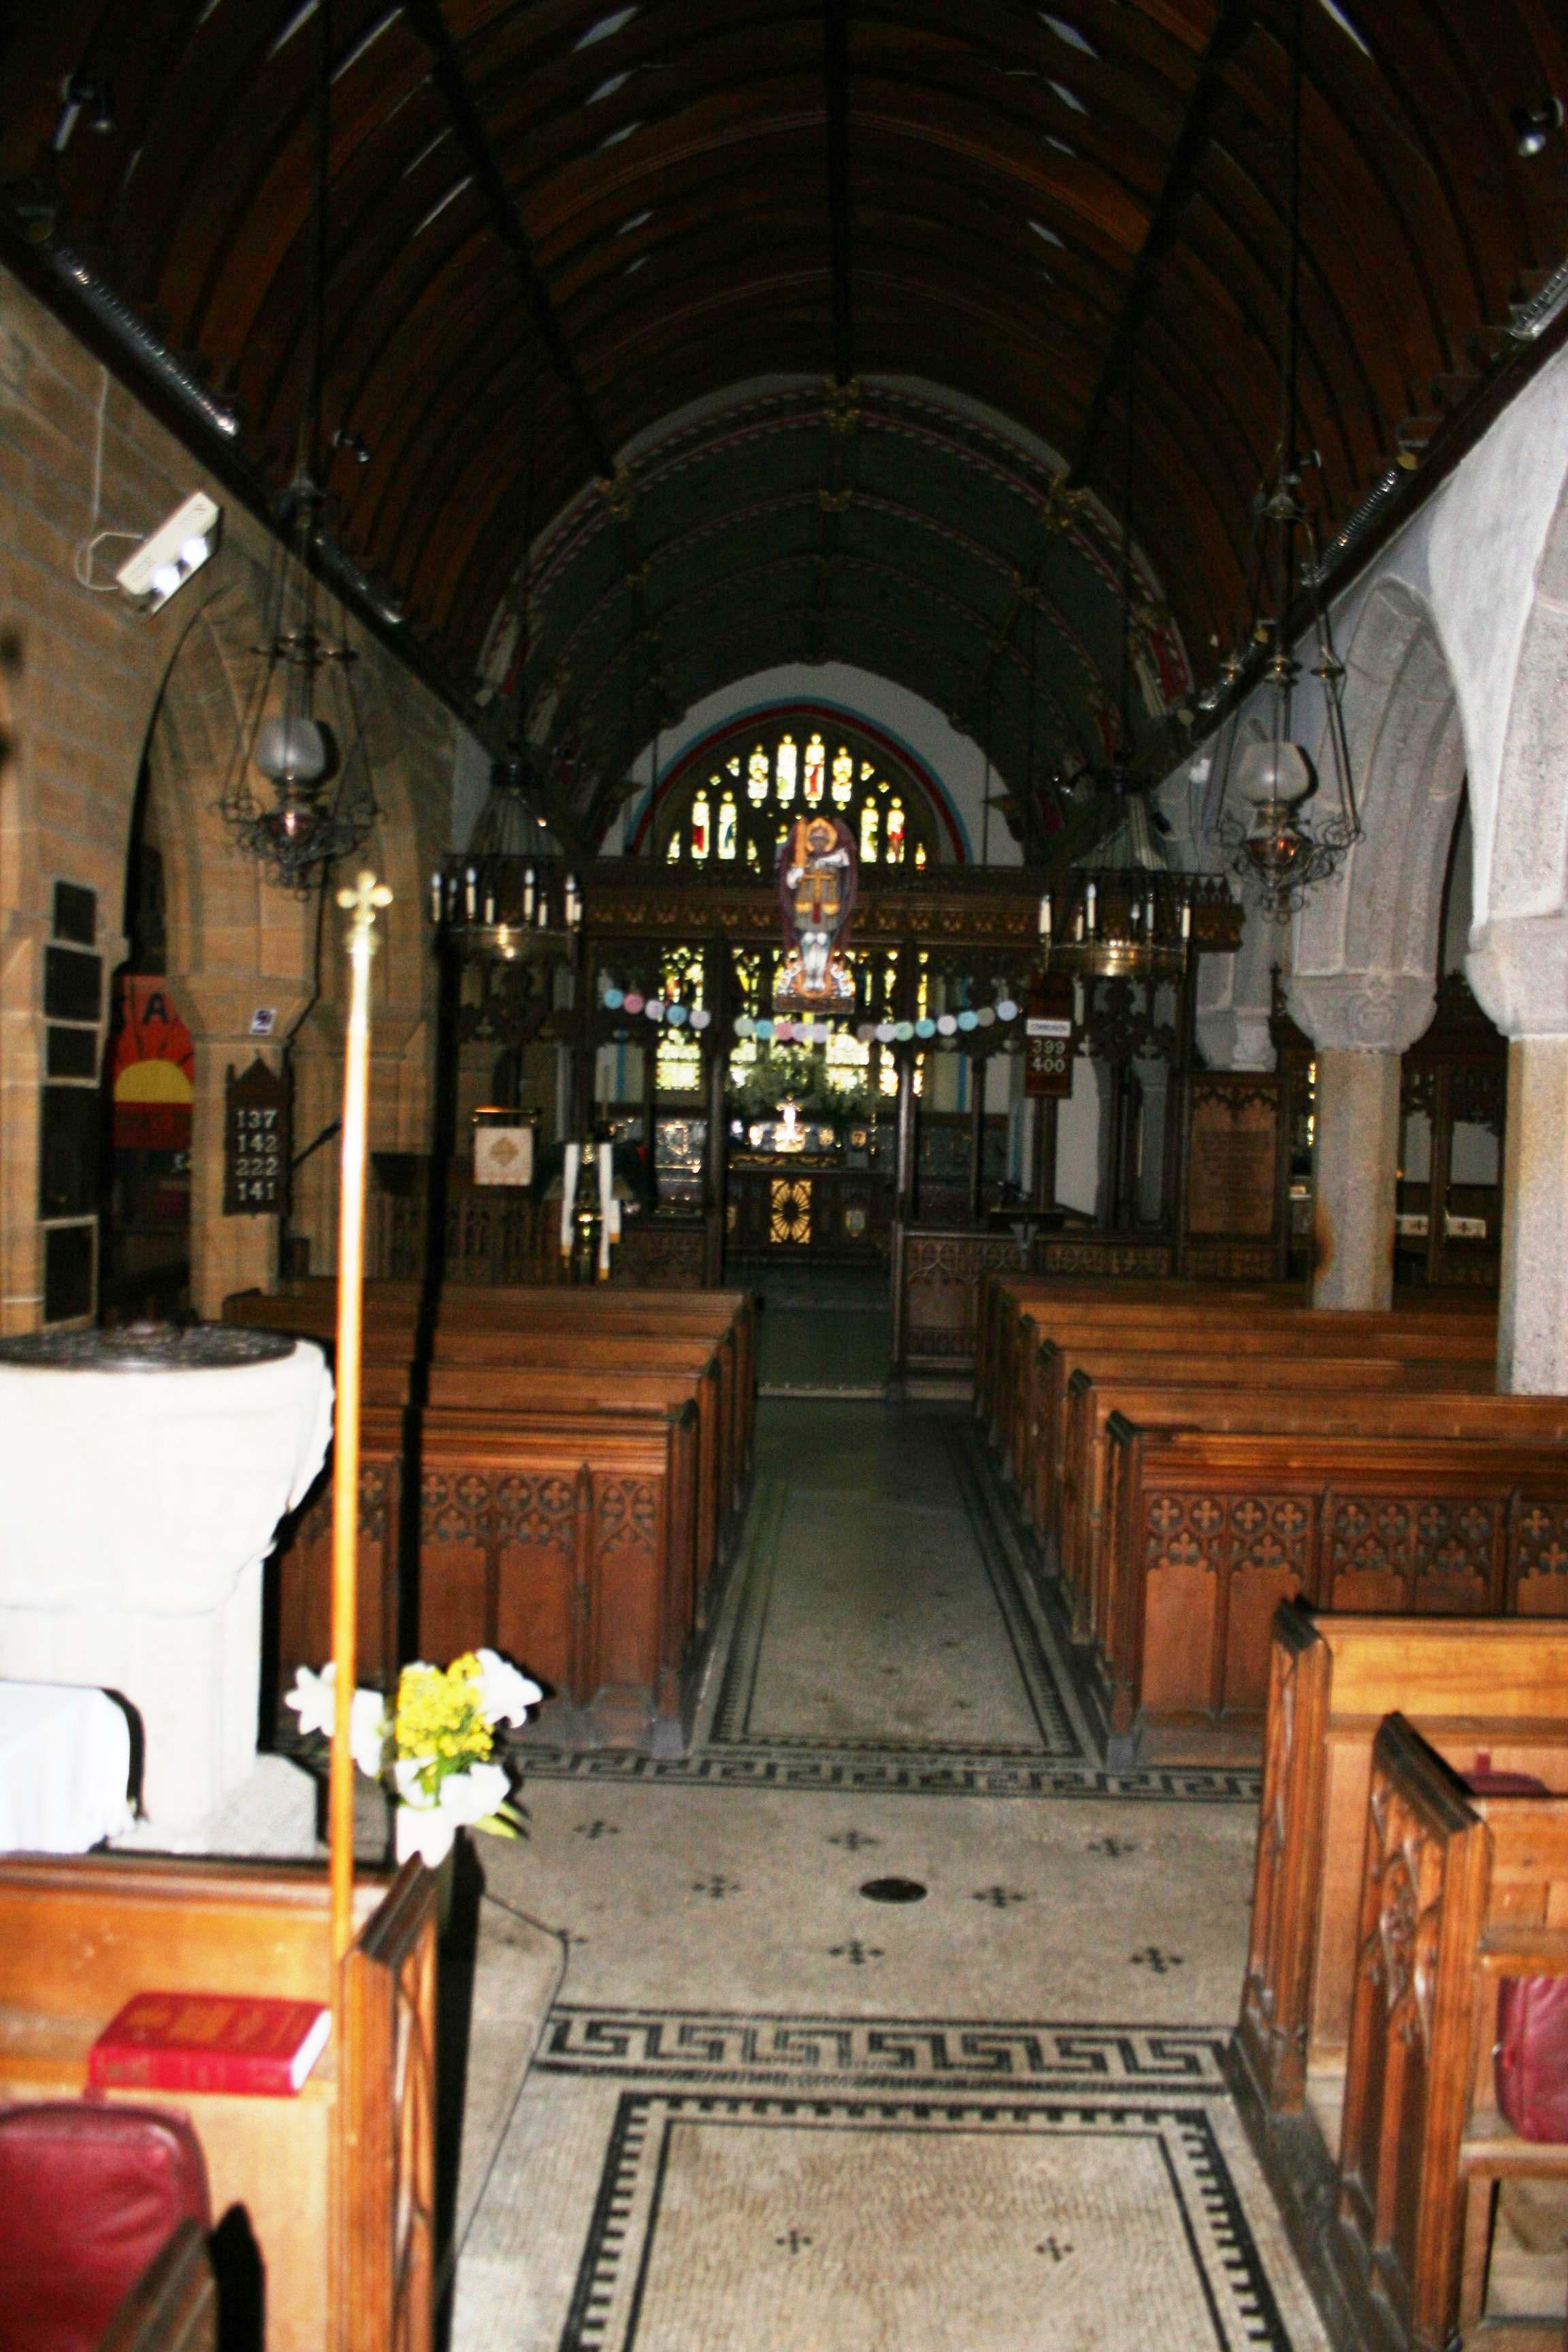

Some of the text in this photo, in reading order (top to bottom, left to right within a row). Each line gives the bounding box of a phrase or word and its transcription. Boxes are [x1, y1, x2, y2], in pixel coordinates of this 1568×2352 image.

[1032, 1058, 1065, 1073] 400
[236, 1110, 278, 1128] 137
[238, 1134, 278, 1153] 142
[235, 1158, 278, 1176] 222
[237, 1182, 275, 1200] 141
